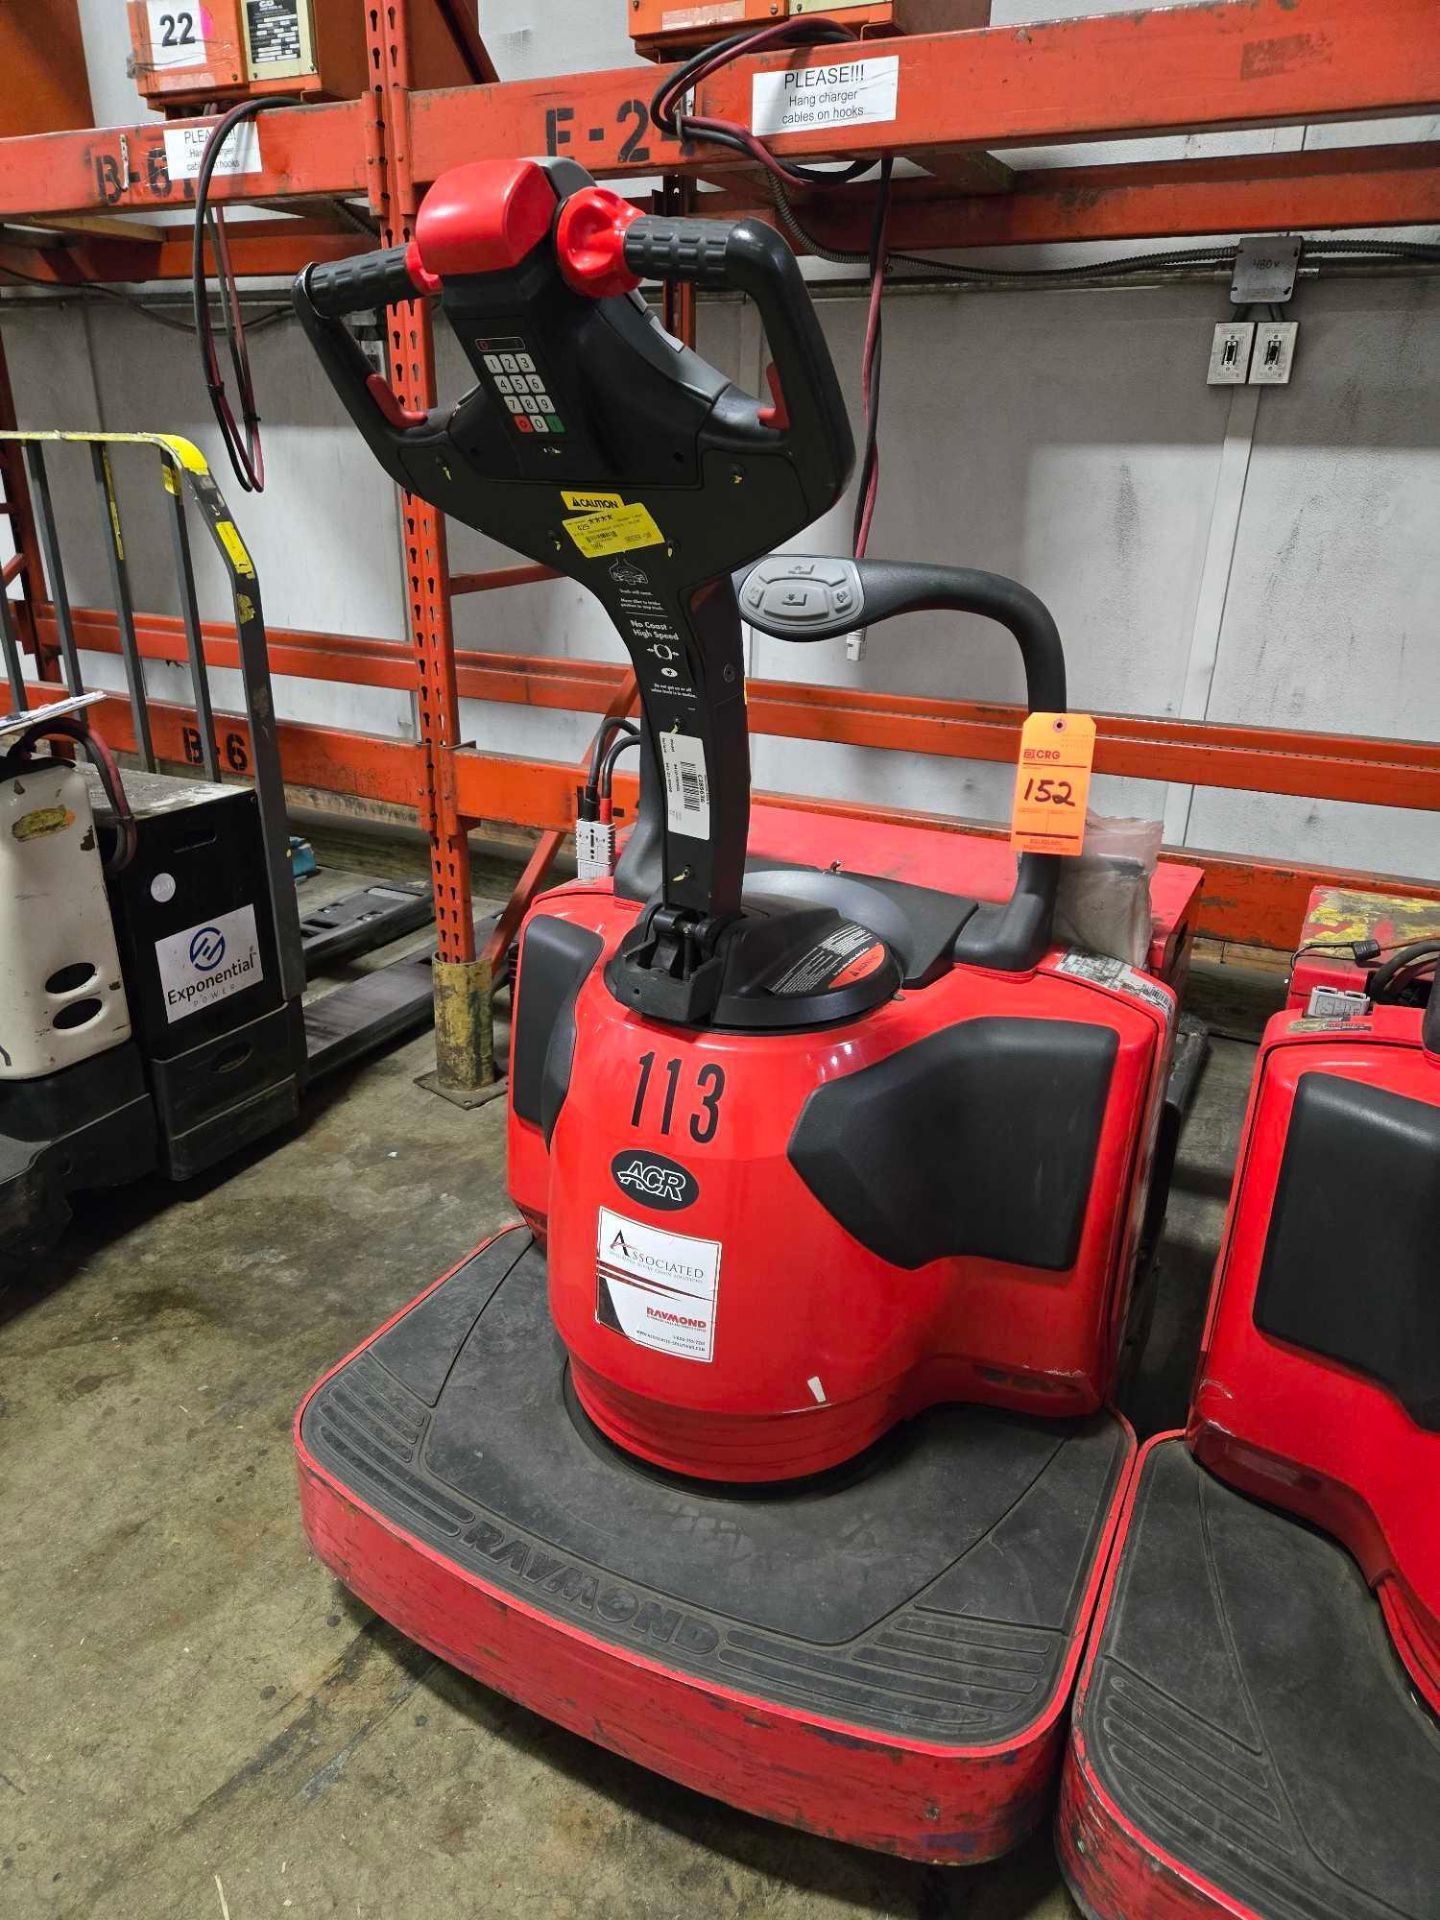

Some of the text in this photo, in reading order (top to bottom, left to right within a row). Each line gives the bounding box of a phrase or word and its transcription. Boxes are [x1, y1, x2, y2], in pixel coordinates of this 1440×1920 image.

[159, 12, 196, 47] 22
[784, 64, 865, 89] PLEASE!!!
[789, 90, 858, 107] Hang charger
[782, 105, 864, 125] cables on hooks
[580, 498, 619, 509] CAUTION
[630, 620, 644, 628] No
[644, 621, 667, 630] Coast
[632, 628, 679, 640] High Speed
[1036, 749, 1060, 760] CRG
[1024, 778, 1075, 807] 152
[167, 953, 255, 1006] Exponential
[193, 983, 236, 1008] POWER
[631, 1051, 725, 1143] 113
[616, 1160, 687, 1202] ACR
[646, 1306, 707, 1329] RAYMOND
[461, 1520, 720, 1655] RAYMOND
